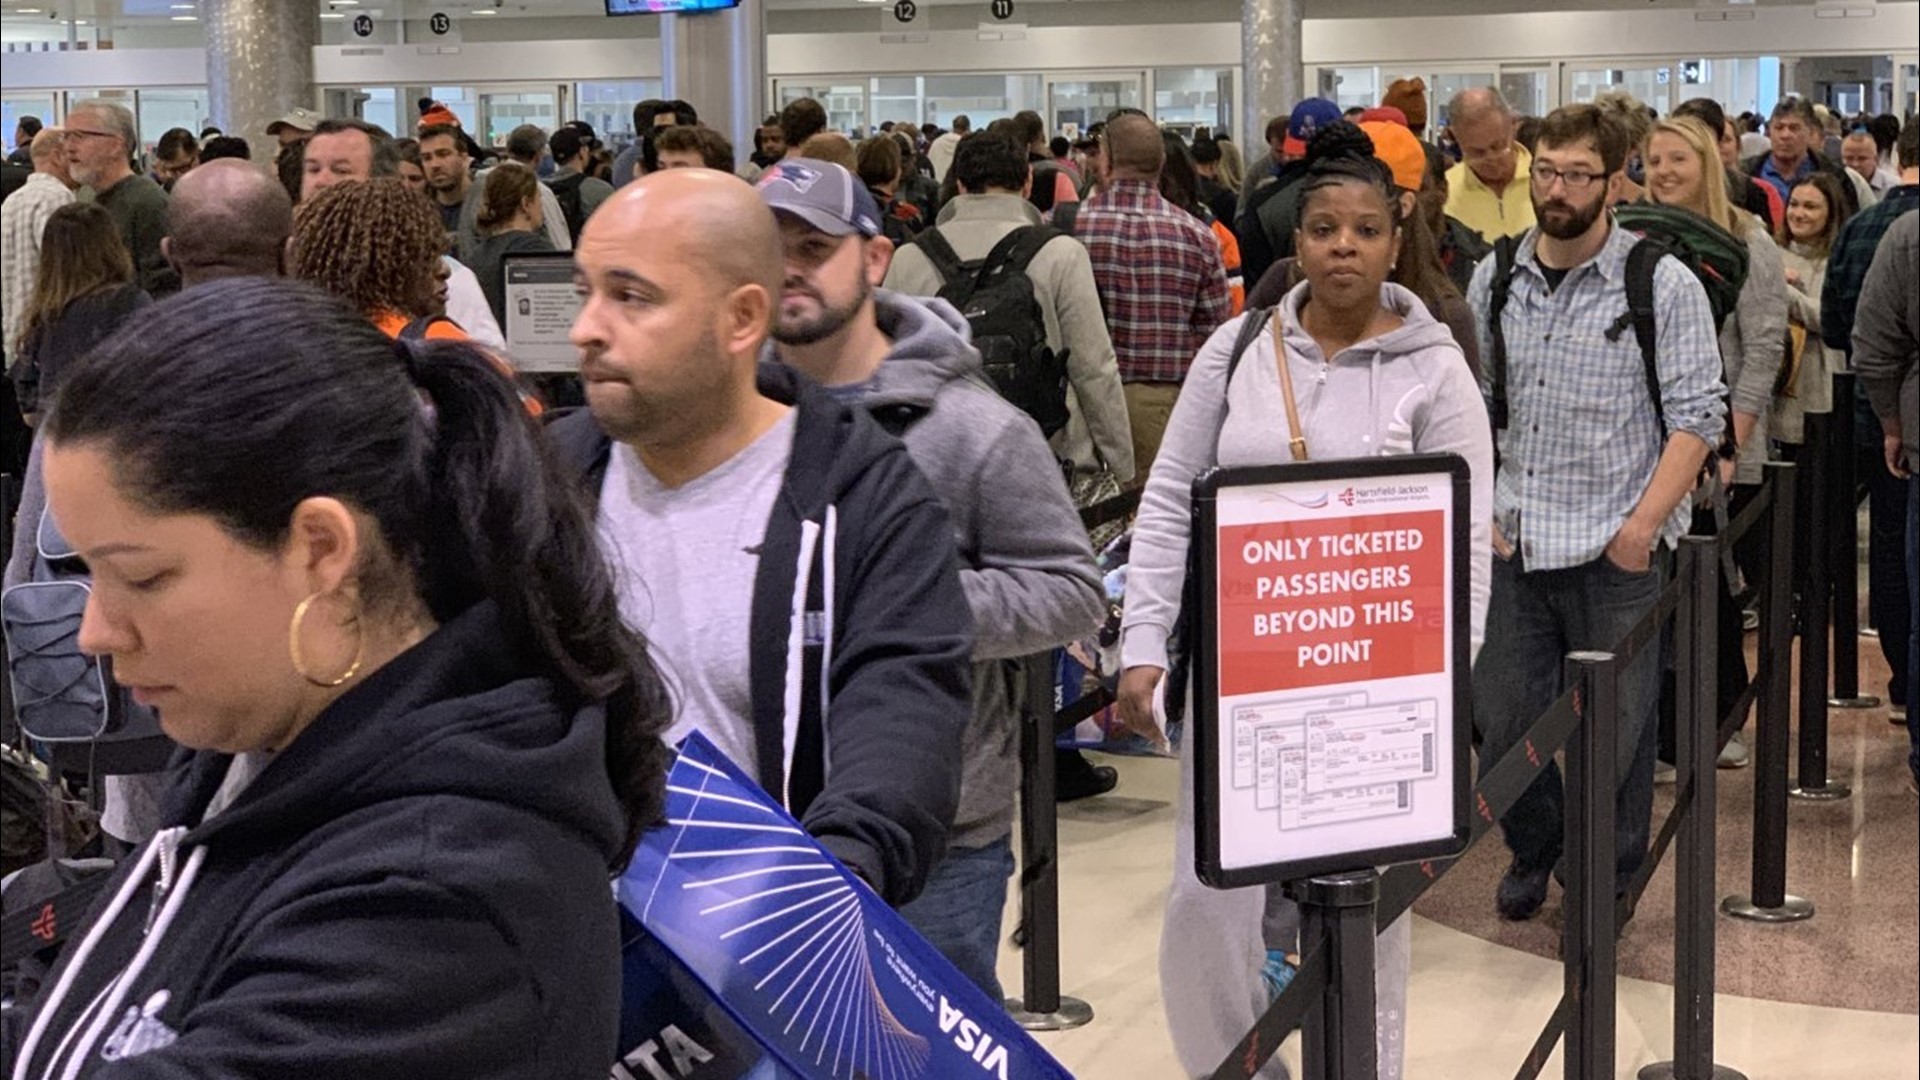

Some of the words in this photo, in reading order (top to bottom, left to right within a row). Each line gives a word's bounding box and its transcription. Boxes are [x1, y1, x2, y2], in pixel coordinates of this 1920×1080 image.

[898, 3, 913, 19] 12
[996, 0, 1009, 16] 11
[356, 19, 371, 32] 14
[434, 17, 448, 31] 13
[1242, 537, 1312, 564] ONLY
[1319, 529, 1423, 557] TICKETED
[1256, 565, 1411, 599] PASSENGERS
[1254, 606, 1355, 636] BEYOND
[1362, 600, 1414, 625] THIS
[1298, 639, 1372, 667] POINT
[918, 979, 936, 1001] you
[938, 994, 1008, 1080] VISA
